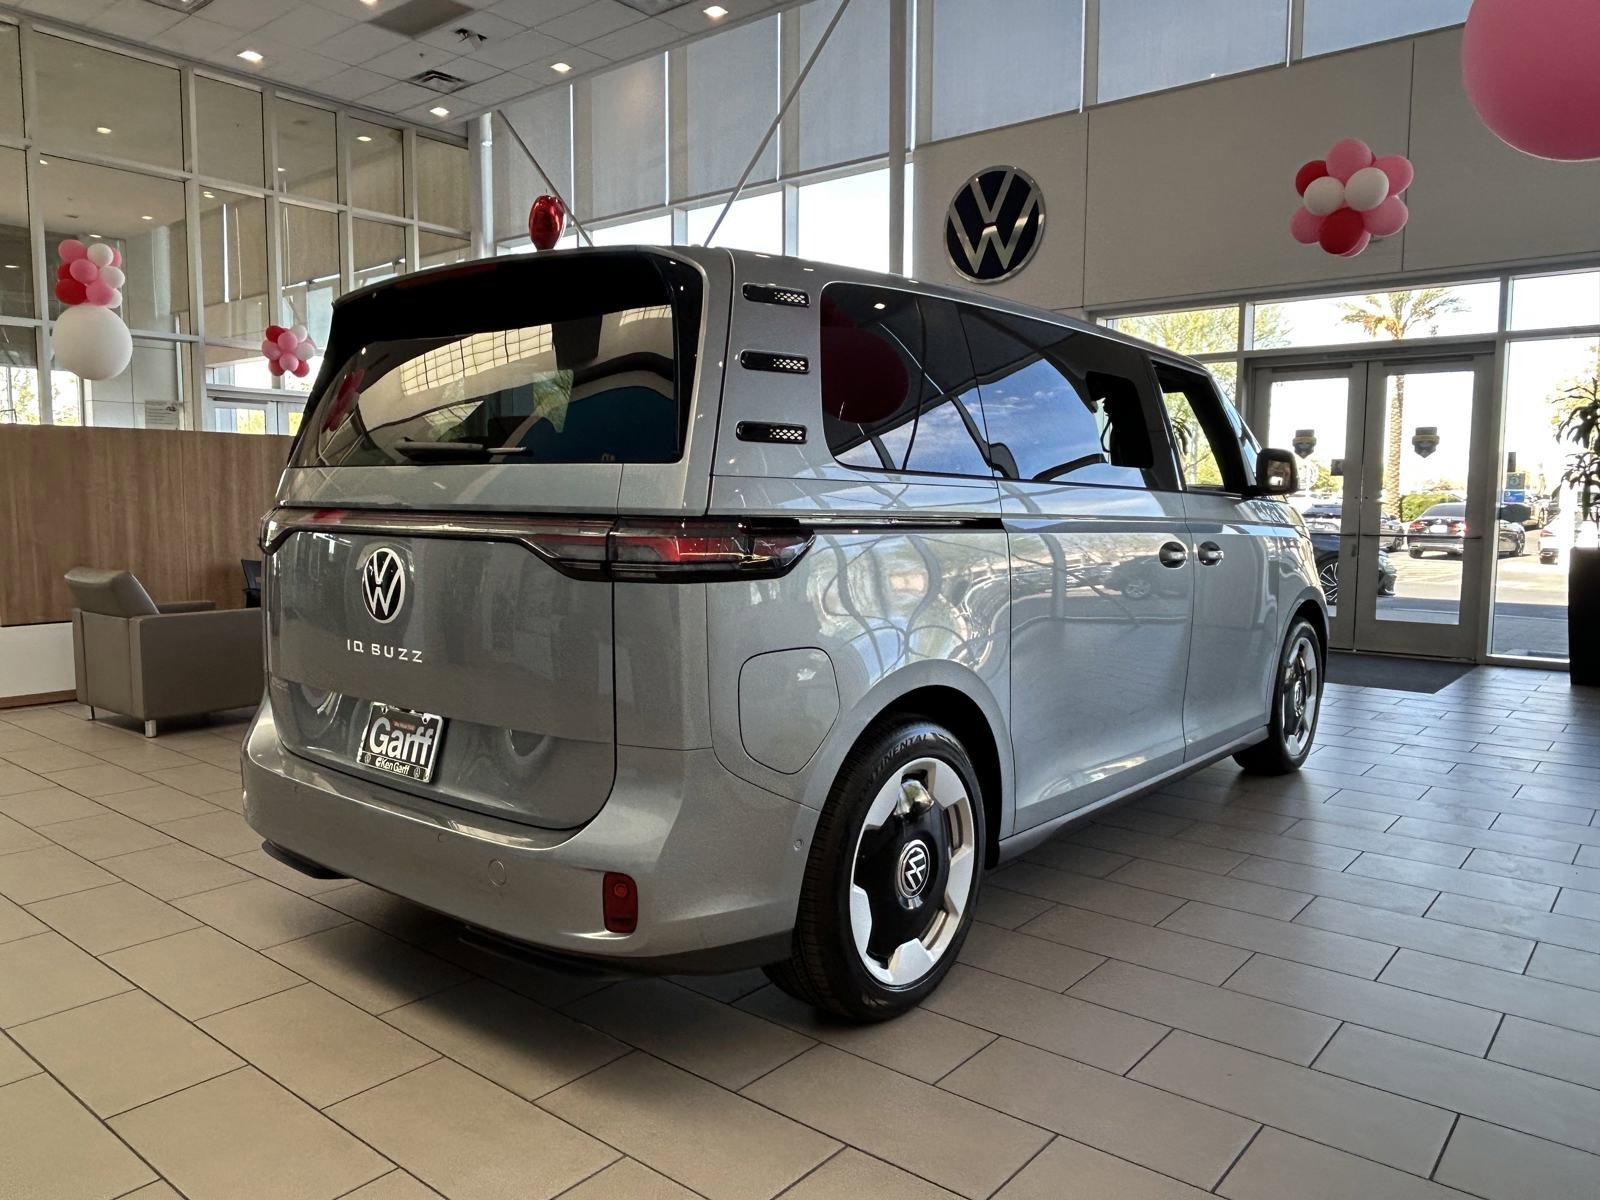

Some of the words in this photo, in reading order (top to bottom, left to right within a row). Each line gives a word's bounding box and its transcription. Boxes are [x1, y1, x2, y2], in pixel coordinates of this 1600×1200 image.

[944, 165, 1045, 283] VW
[362, 548, 405, 624] VW
[371, 643, 423, 663] BUZZ
[369, 717, 434, 765] Garff
[380, 758, 394, 771] Ken
[393, 762, 410, 775] Garff
